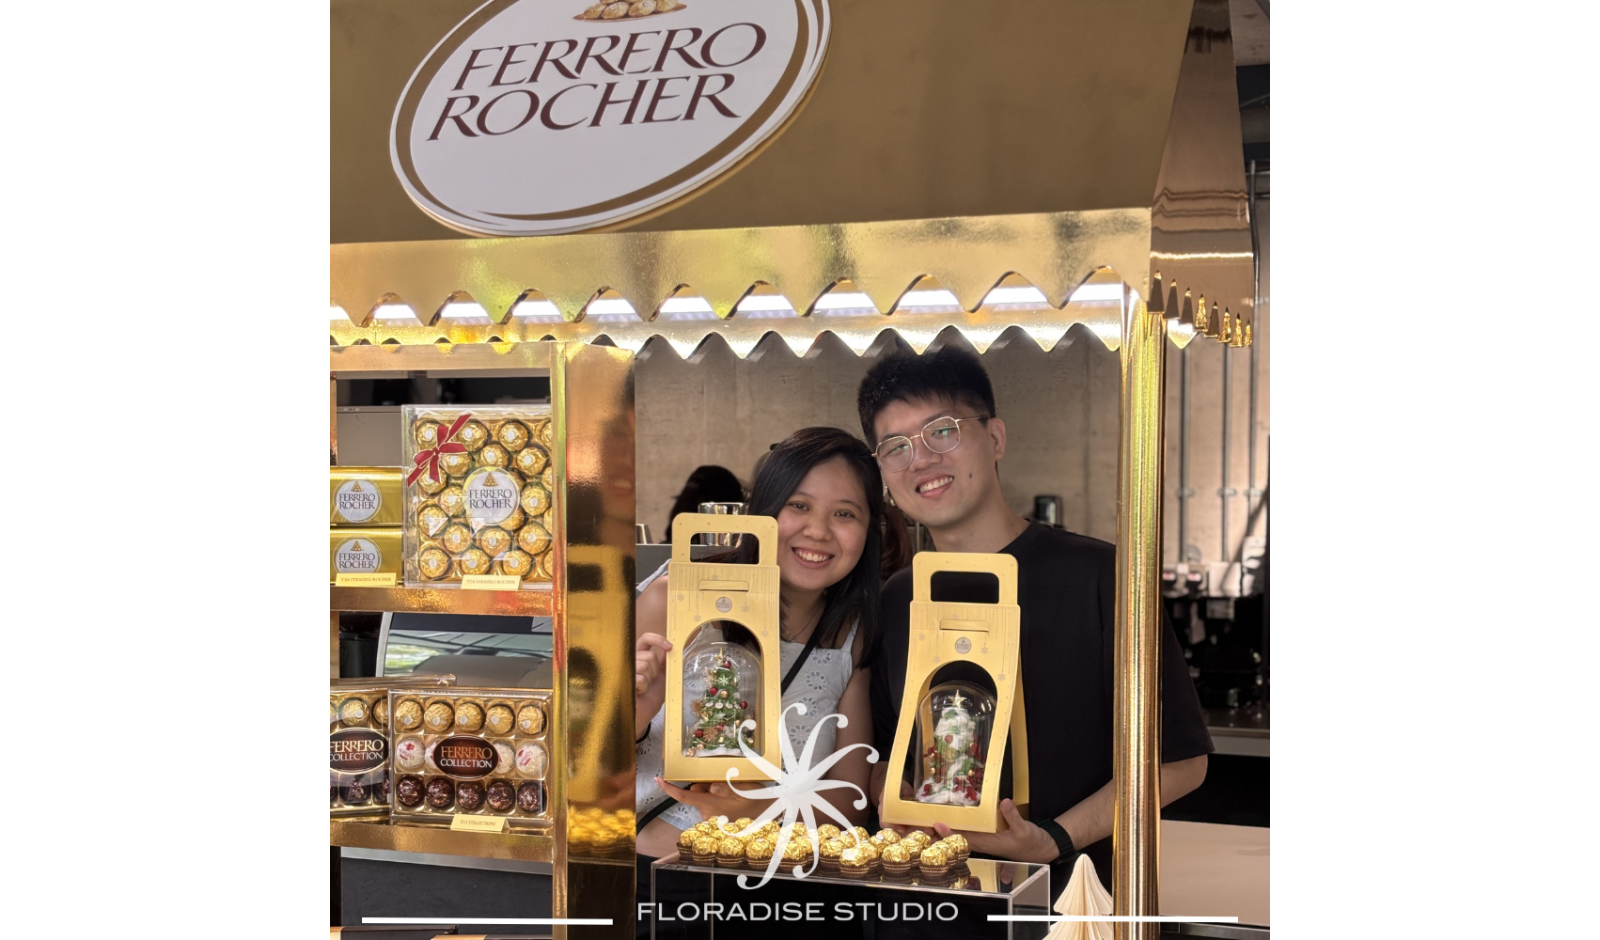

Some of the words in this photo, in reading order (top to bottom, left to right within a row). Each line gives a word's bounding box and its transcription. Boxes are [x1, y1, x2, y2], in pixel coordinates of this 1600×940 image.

[452, 22, 767, 91] FERRERO
[426, 73, 742, 141] ROCHER
[338, 493, 376, 503] FERRERO
[469, 488, 513, 499] FERRERO
[339, 501, 376, 510] ROCHER
[469, 498, 512, 510] ROCHER
[338, 553, 376, 562] FERRERO
[339, 560, 376, 569] ROCHER
[440, 745, 493, 759] FERRERO
[440, 757, 492, 769] COLLECTION
